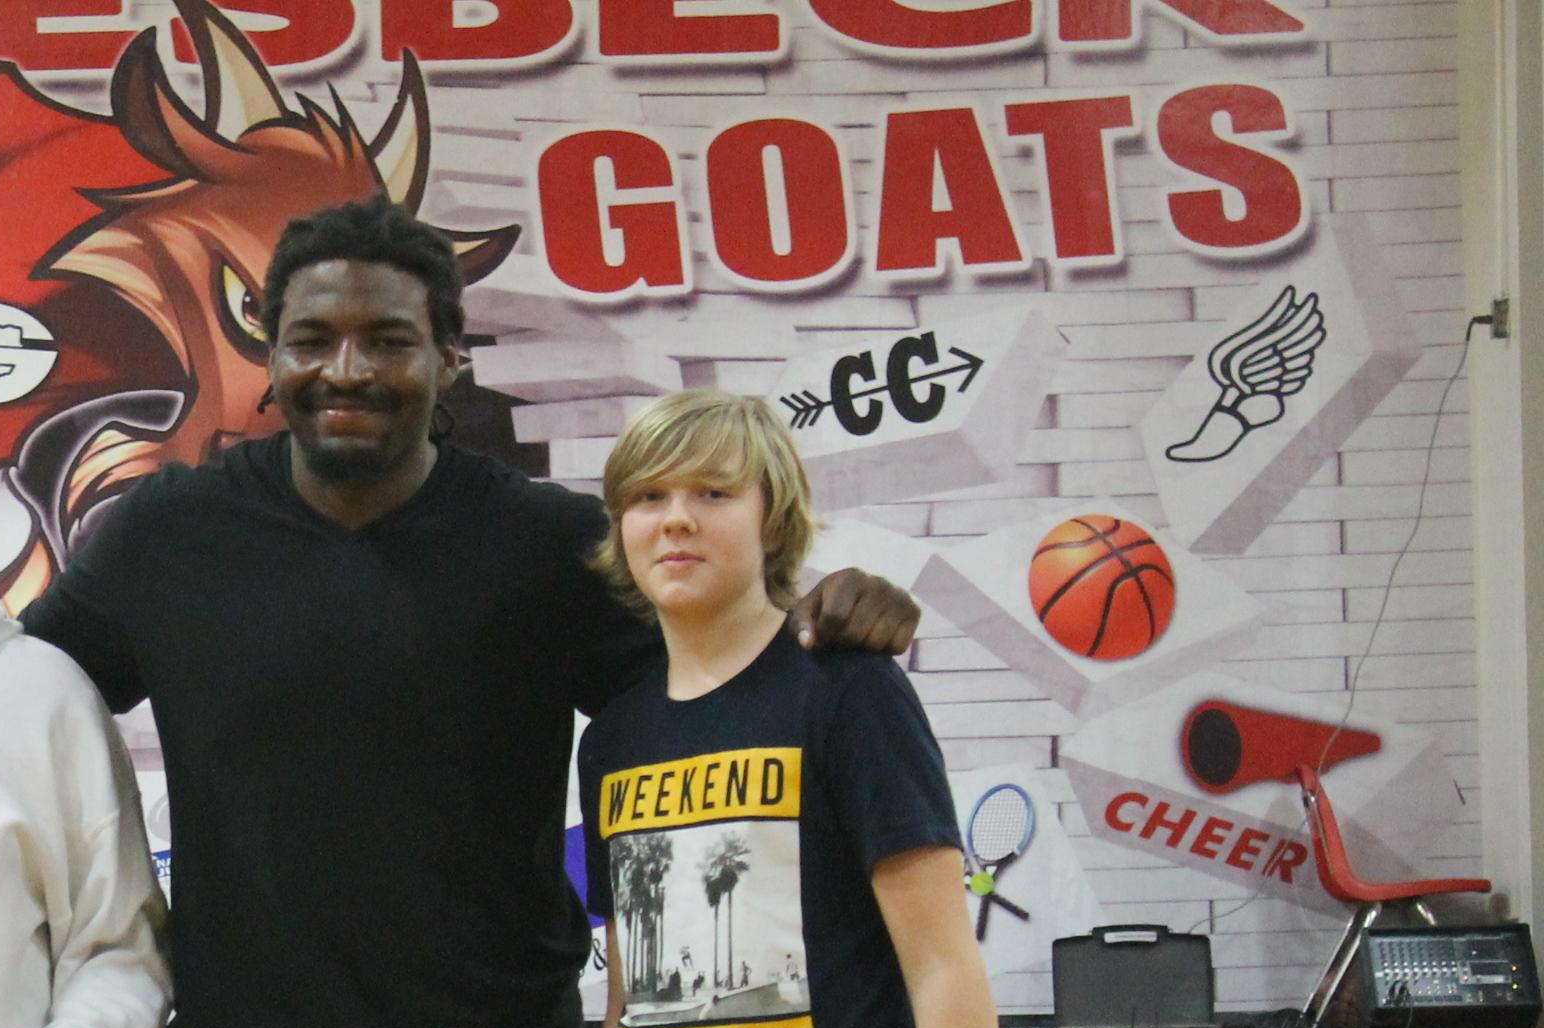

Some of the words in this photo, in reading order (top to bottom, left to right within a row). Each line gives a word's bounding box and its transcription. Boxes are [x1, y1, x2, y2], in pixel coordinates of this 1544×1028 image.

[538, 85, 1302, 294] GOATS
[830, 331, 946, 436] CC
[608, 757, 785, 827] WEEKEND
[1103, 791, 1309, 885] CHEER
